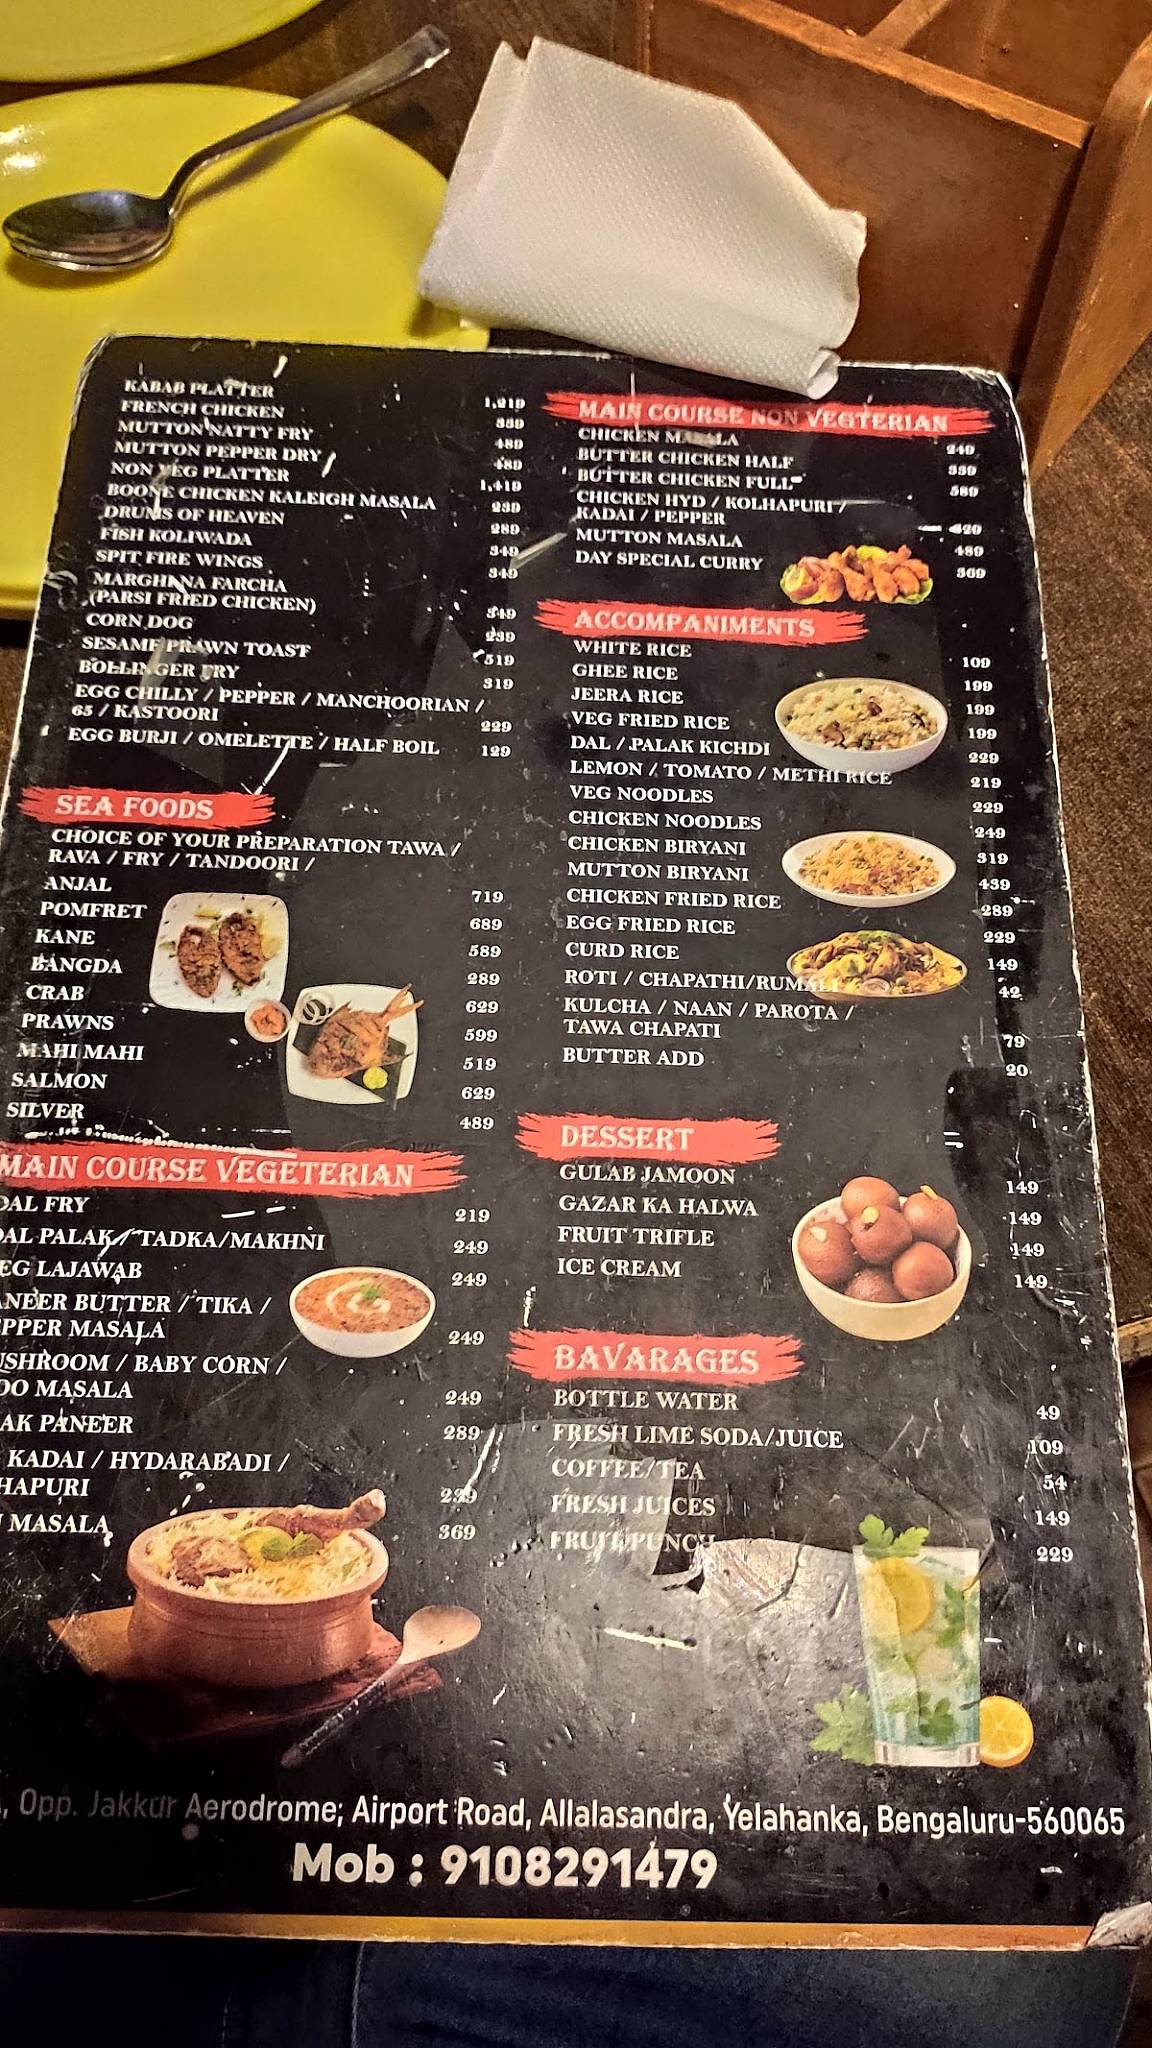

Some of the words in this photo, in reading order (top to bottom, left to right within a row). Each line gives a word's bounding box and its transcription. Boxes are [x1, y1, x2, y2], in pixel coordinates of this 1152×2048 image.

[124, 380, 185, 394] KABAB
[579, 402, 642, 421] MAIN
[648, 404, 744, 424] COURSE
[750, 408, 799, 426] NON
[808, 409, 948, 432] VEGTERIAN
[118, 421, 203, 436] MUTTON
[278, 426, 314, 440] FRY
[115, 441, 200, 456] MUTTON
[206, 445, 278, 460] PEPPER
[283, 447, 321, 462] DRY
[578, 448, 653, 463] BUTTER
[659, 451, 739, 466] CHICKEN
[745, 455, 794, 469] HALF
[111, 462, 152, 477] NON
[203, 466, 289, 481] PLATTER
[179, 486, 264, 502] CHICKEN
[270, 490, 354, 506] KALEIGH
[360, 494, 436, 510] MASALA
[576, 490, 659, 506] CHICKEN
[665, 493, 706, 507] HYD
[178, 507, 203, 522] OF
[209, 509, 285, 525] HEAVEN
[100, 527, 144, 541] FISH
[149, 529, 252, 546] KOLIWADA
[575, 550, 611, 565] DAY
[617, 552, 694, 568] SPECIAL
[700, 556, 763, 571] CURRY
[222, 596, 316, 614] CHICKEN)
[86, 614, 142, 628] CORN
[148, 616, 193, 630] DOG
[574, 611, 815, 637] ACCOMPANIMENTS
[574, 640, 642, 655] WHITE
[647, 643, 691, 657] RICE
[962, 656, 991, 669] 109
[483, 678, 514, 691] 319
[75, 684, 120, 698] EGG
[220, 689, 296, 705] PEPPER
[317, 693, 469, 713] MANCHOORIAN
[72, 705, 93, 718] 65
[115, 705, 219, 722] KASTOORI
[572, 710, 614, 726] VEG
[619, 712, 679, 728] FRIED
[684, 715, 729, 730] RICE
[68, 728, 113, 743] EGG
[118, 730, 177, 745] BURJI
[198, 733, 313, 750] OMELETTE
[334, 737, 388, 753] HALF
[393, 740, 440, 755] BOIL
[570, 735, 611, 750] DAL
[631, 738, 695, 753] PALAK
[700, 740, 770, 756] KICHDI
[481, 745, 511, 758] 129
[969, 752, 999, 764] 229
[570, 761, 643, 776] LEMON
[664, 764, 752, 780] TOMATO
[772, 767, 841, 782] METHI
[846, 770, 892, 785] RICE
[971, 776, 1001, 789] 219
[570, 785, 612, 800] VEG
[618, 787, 713, 804] NOODLES
[55, 795, 114, 816] SEA
[123, 797, 214, 819] FOODS
[973, 802, 1003, 814] 229
[52, 829, 132, 845] CHOICE
[138, 832, 167, 846] OF
[173, 833, 230, 849] YOUR
[236, 835, 381, 854] PREPARATION
[387, 840, 445, 857] TAWA
[568, 836, 660, 853] CHICKEN
[665, 839, 746, 856] BIRYANI
[48, 849, 100, 864] RAVA
[123, 851, 163, 867] FRY
[186, 853, 299, 871] TANDOORI
[977, 852, 1008, 865] 319
[43, 876, 111, 892] ANJAL
[979, 878, 1010, 891] 439
[472, 890, 503, 903] 719
[567, 888, 659, 906] CHICKEN
[665, 891, 728, 908] FRIED
[733, 893, 781, 909] RICE
[40, 902, 147, 919] POMFRET
[470, 917, 502, 931] 689
[35, 929, 95, 945] KANE
[565, 943, 627, 959] CURD
[632, 945, 679, 960] RICE
[31, 957, 122, 974] BANGDA
[987, 958, 1018, 971] 149
[467, 972, 500, 986] 289
[564, 970, 618, 986] ROTI
[26, 985, 85, 1001] CRAB
[563, 998, 652, 1015] KULCHA
[674, 1001, 732, 1017] NAAN
[755, 1004, 838, 1021] PAROTA
[21, 1013, 114, 1031] PRAWNS
[563, 1019, 622, 1036] TAWA
[629, 1021, 721, 1039] CHAPATI
[464, 1029, 497, 1042] 599
[17, 1043, 79, 1060] MAHI
[84, 1044, 144, 1061] MAHI
[563, 1047, 651, 1065] BUTTER
[657, 1050, 704, 1066] ADD
[463, 1057, 496, 1071] 519
[1006, 1064, 1028, 1077] 20
[11, 1072, 107, 1090] SALMON
[6, 1102, 84, 1119] SILVER
[459, 1116, 494, 1130] 489
[561, 1125, 694, 1152] DESSERT
[86, 1156, 204, 1184] COURSE
[217, 1159, 414, 1188] VEGETERIAN
[560, 1165, 635, 1183] GULAB
[641, 1167, 735, 1185] JAMOON
[1006, 1180, 1039, 1194] 149
[44, 1197, 89, 1213] FRY
[559, 1195, 635, 1214] GAZAR
[643, 1197, 673, 1215] KA
[680, 1198, 758, 1217] HALWA
[455, 1209, 490, 1222] 219
[558, 1226, 627, 1245] FRUIT
[634, 1228, 714, 1247] TRIFLE
[37, 1261, 142, 1279] LAJAWAB
[557, 1258, 595, 1276] ICE
[601, 1259, 681, 1278] CREAM
[452, 1272, 487, 1287] 249
[1014, 1274, 1048, 1289] 149
[74, 1295, 171, 1312] BUTTER
[197, 1297, 252, 1314] TIKA
[68, 1320, 165, 1339] MASALA
[134, 1356, 197, 1373] BABY
[202, 1357, 269, 1374] CORN
[554, 1344, 759, 1375] BAVARAGES
[36, 1380, 133, 1399] MASALA
[445, 1391, 481, 1405] 249
[554, 1390, 649, 1410] BOTTLE
[655, 1392, 738, 1411] WATER
[1036, 1405, 1061, 1420] 49
[39, 1415, 133, 1433] PANEER
[443, 1426, 480, 1441] 289
[553, 1425, 628, 1444] FRESH
[635, 1427, 695, 1445] LIME
[701, 1428, 844, 1450] SODA/JUICE
[8, 1449, 85, 1468] KADAI
[110, 1452, 271, 1471] HYDARABADI
[552, 1459, 705, 1480] COFFEE/TEA
[1043, 1475, 1066, 1490] 54
[551, 1495, 627, 1515] FRESH
[633, 1497, 715, 1517] JUICES
[9, 1514, 110, 1534] MASALA
[1035, 1511, 1070, 1525] 149
[438, 1525, 475, 1540] 369
[1037, 1547, 1073, 1562] 229
[19, 1788, 77, 1822] Opp.
[352, 1795, 448, 1829] Airport
[454, 1797, 531, 1831] Road,
[540, 1798, 714, 1835] Allalasandra,
[723, 1795, 868, 1837] Yelahanka,
[877, 1806, 1125, 1839] Bengaluru-560065
[292, 1843, 394, 1882] Mob
[411, 1852, 423, 1884] :
[440, 1844, 718, 1888] 9108291479
